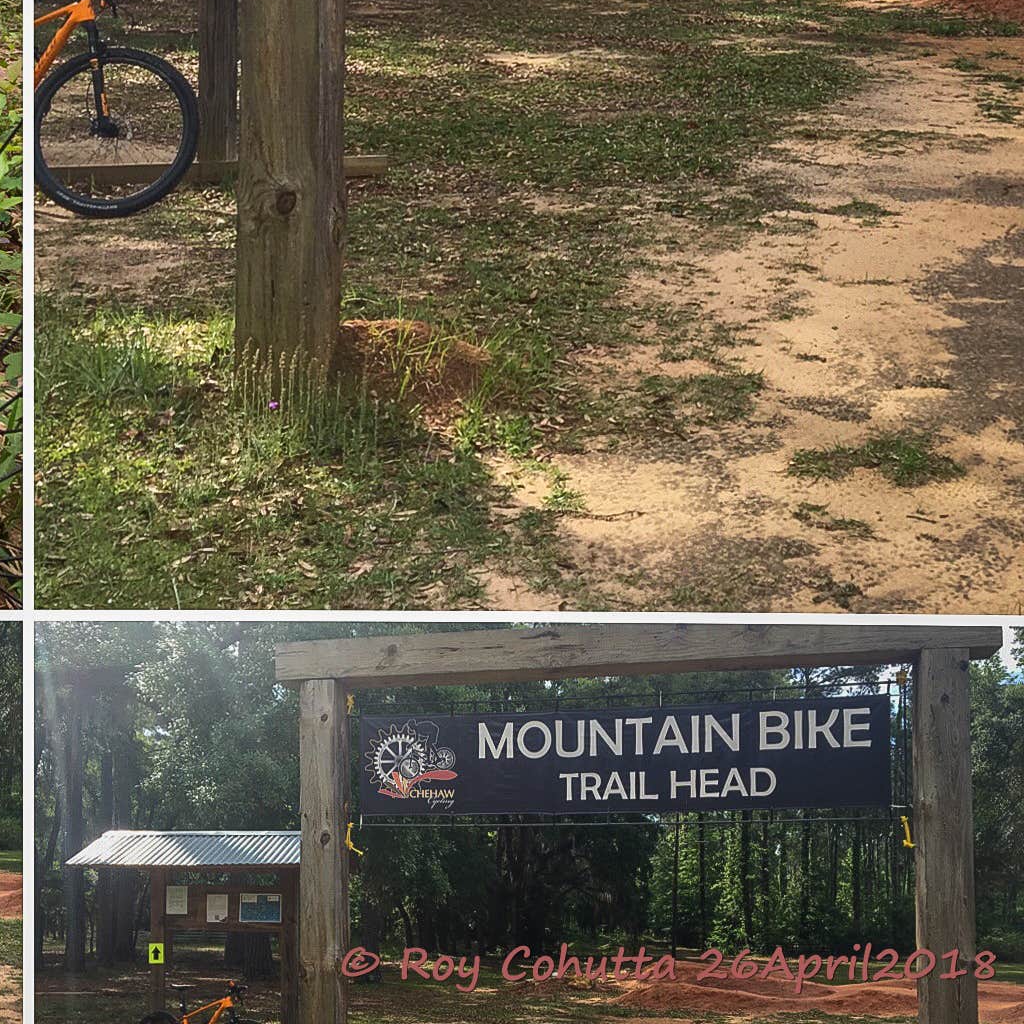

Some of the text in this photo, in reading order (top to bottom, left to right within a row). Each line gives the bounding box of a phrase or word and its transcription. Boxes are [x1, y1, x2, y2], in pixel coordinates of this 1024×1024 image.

[478, 707, 872, 760] MOUNTAIN BIKE
[409, 789, 455, 798] CHEHAW
[559, 767, 777, 801] TRAIL HEAD
